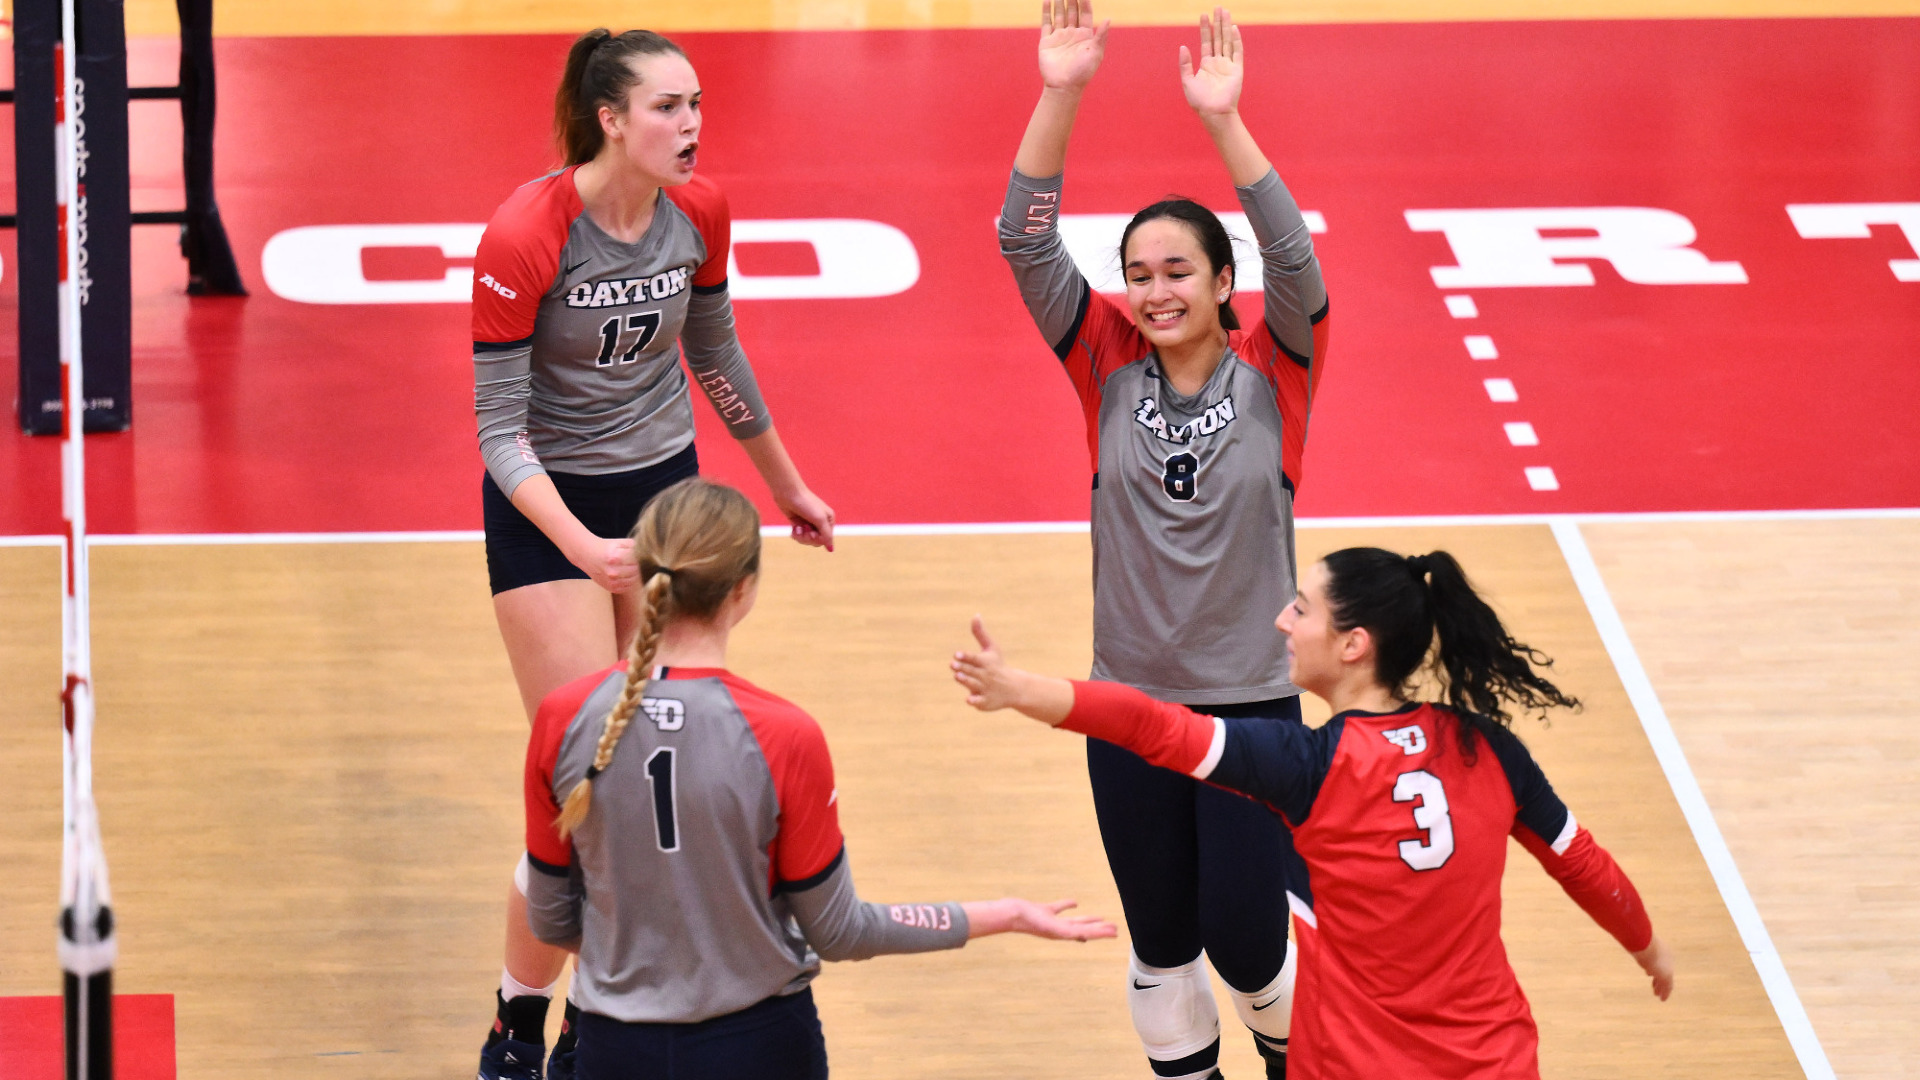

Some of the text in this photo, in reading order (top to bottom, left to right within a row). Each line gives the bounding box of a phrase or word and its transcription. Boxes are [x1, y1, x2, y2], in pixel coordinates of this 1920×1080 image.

[478, 272, 518, 300] A10
[566, 265, 689, 309] DAYTON
[596, 309, 662, 368] 17
[697, 368, 755, 425] LEGACY
[1161, 449, 1200, 503] 8
[644, 746, 680, 853] 1
[1392, 769, 1455, 872] 3
